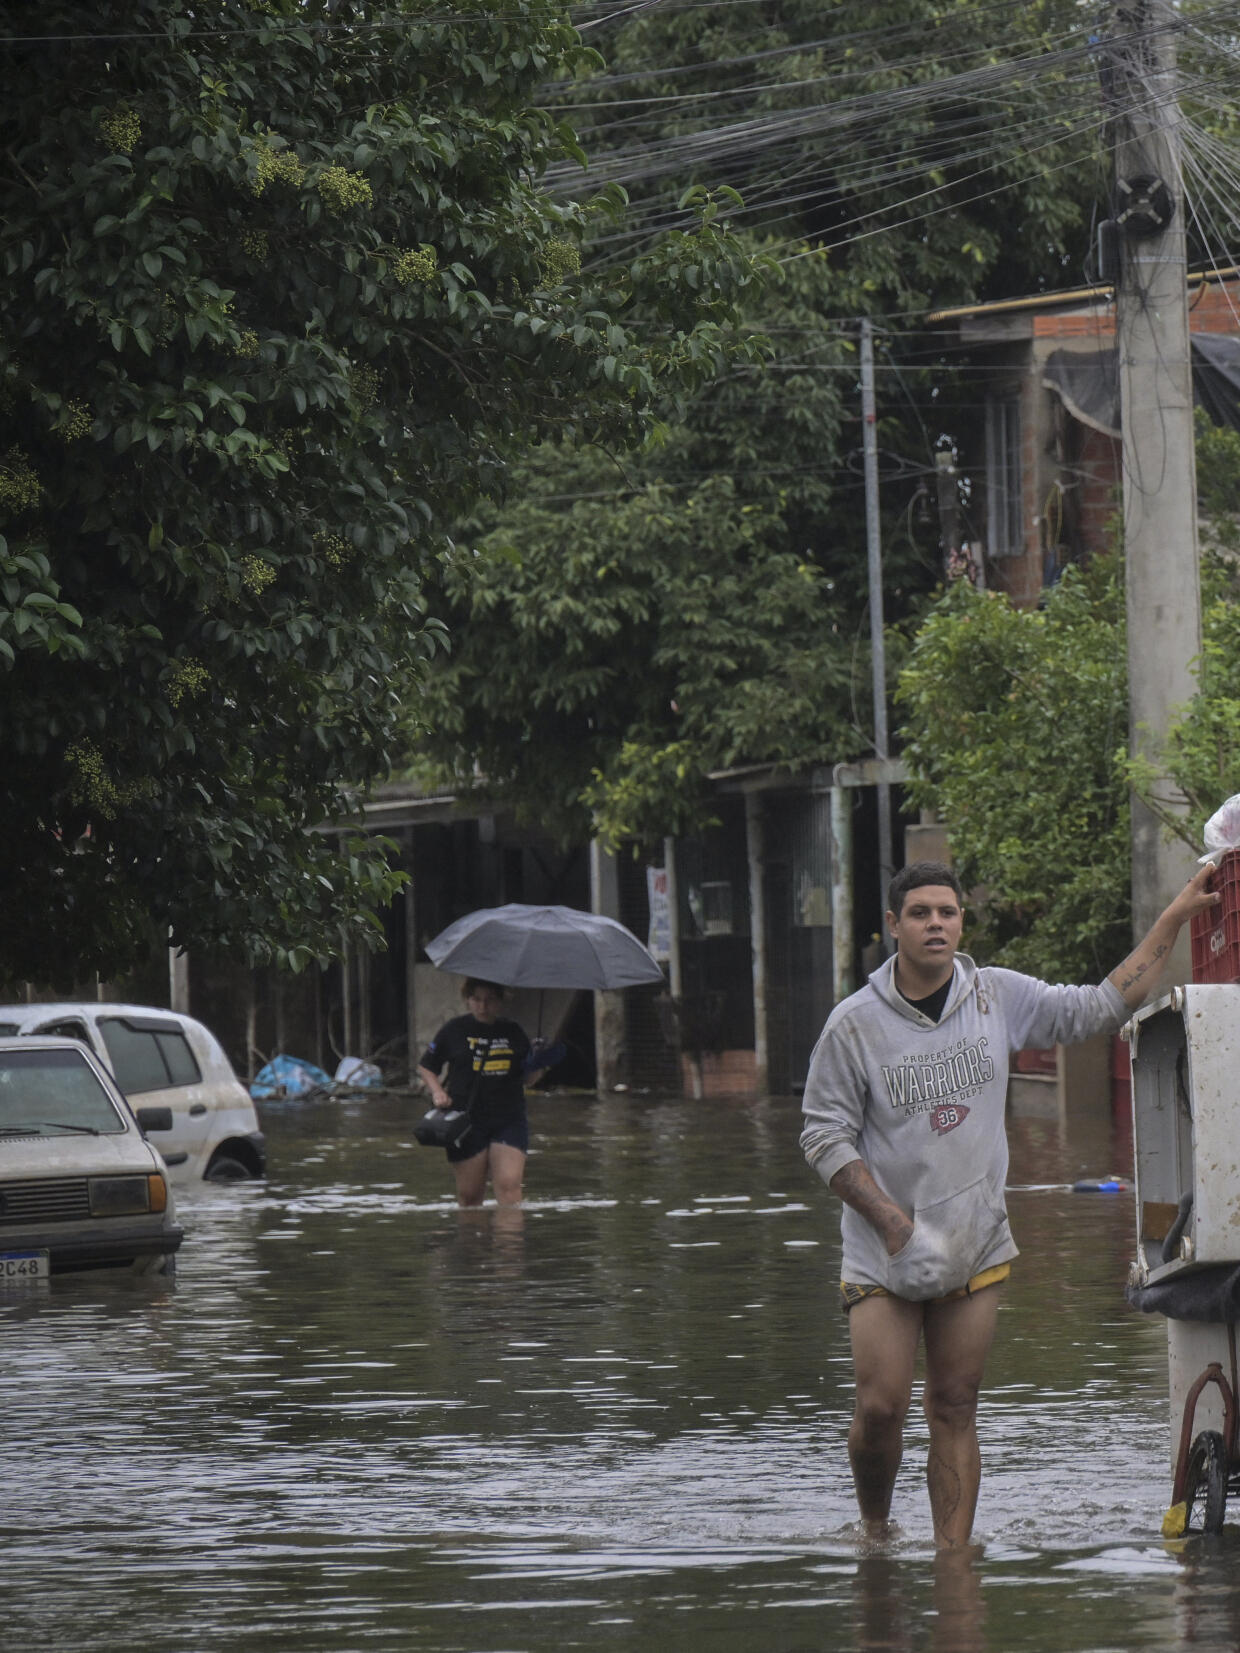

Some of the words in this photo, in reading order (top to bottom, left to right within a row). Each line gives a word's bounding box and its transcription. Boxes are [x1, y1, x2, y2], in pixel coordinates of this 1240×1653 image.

[903, 1046, 953, 1063] PROPERTY
[957, 1037, 968, 1050] OF
[881, 1036, 994, 1108] WARRIORS
[904, 1096, 958, 1117] ATHLETICS
[938, 1108, 958, 1127] 36
